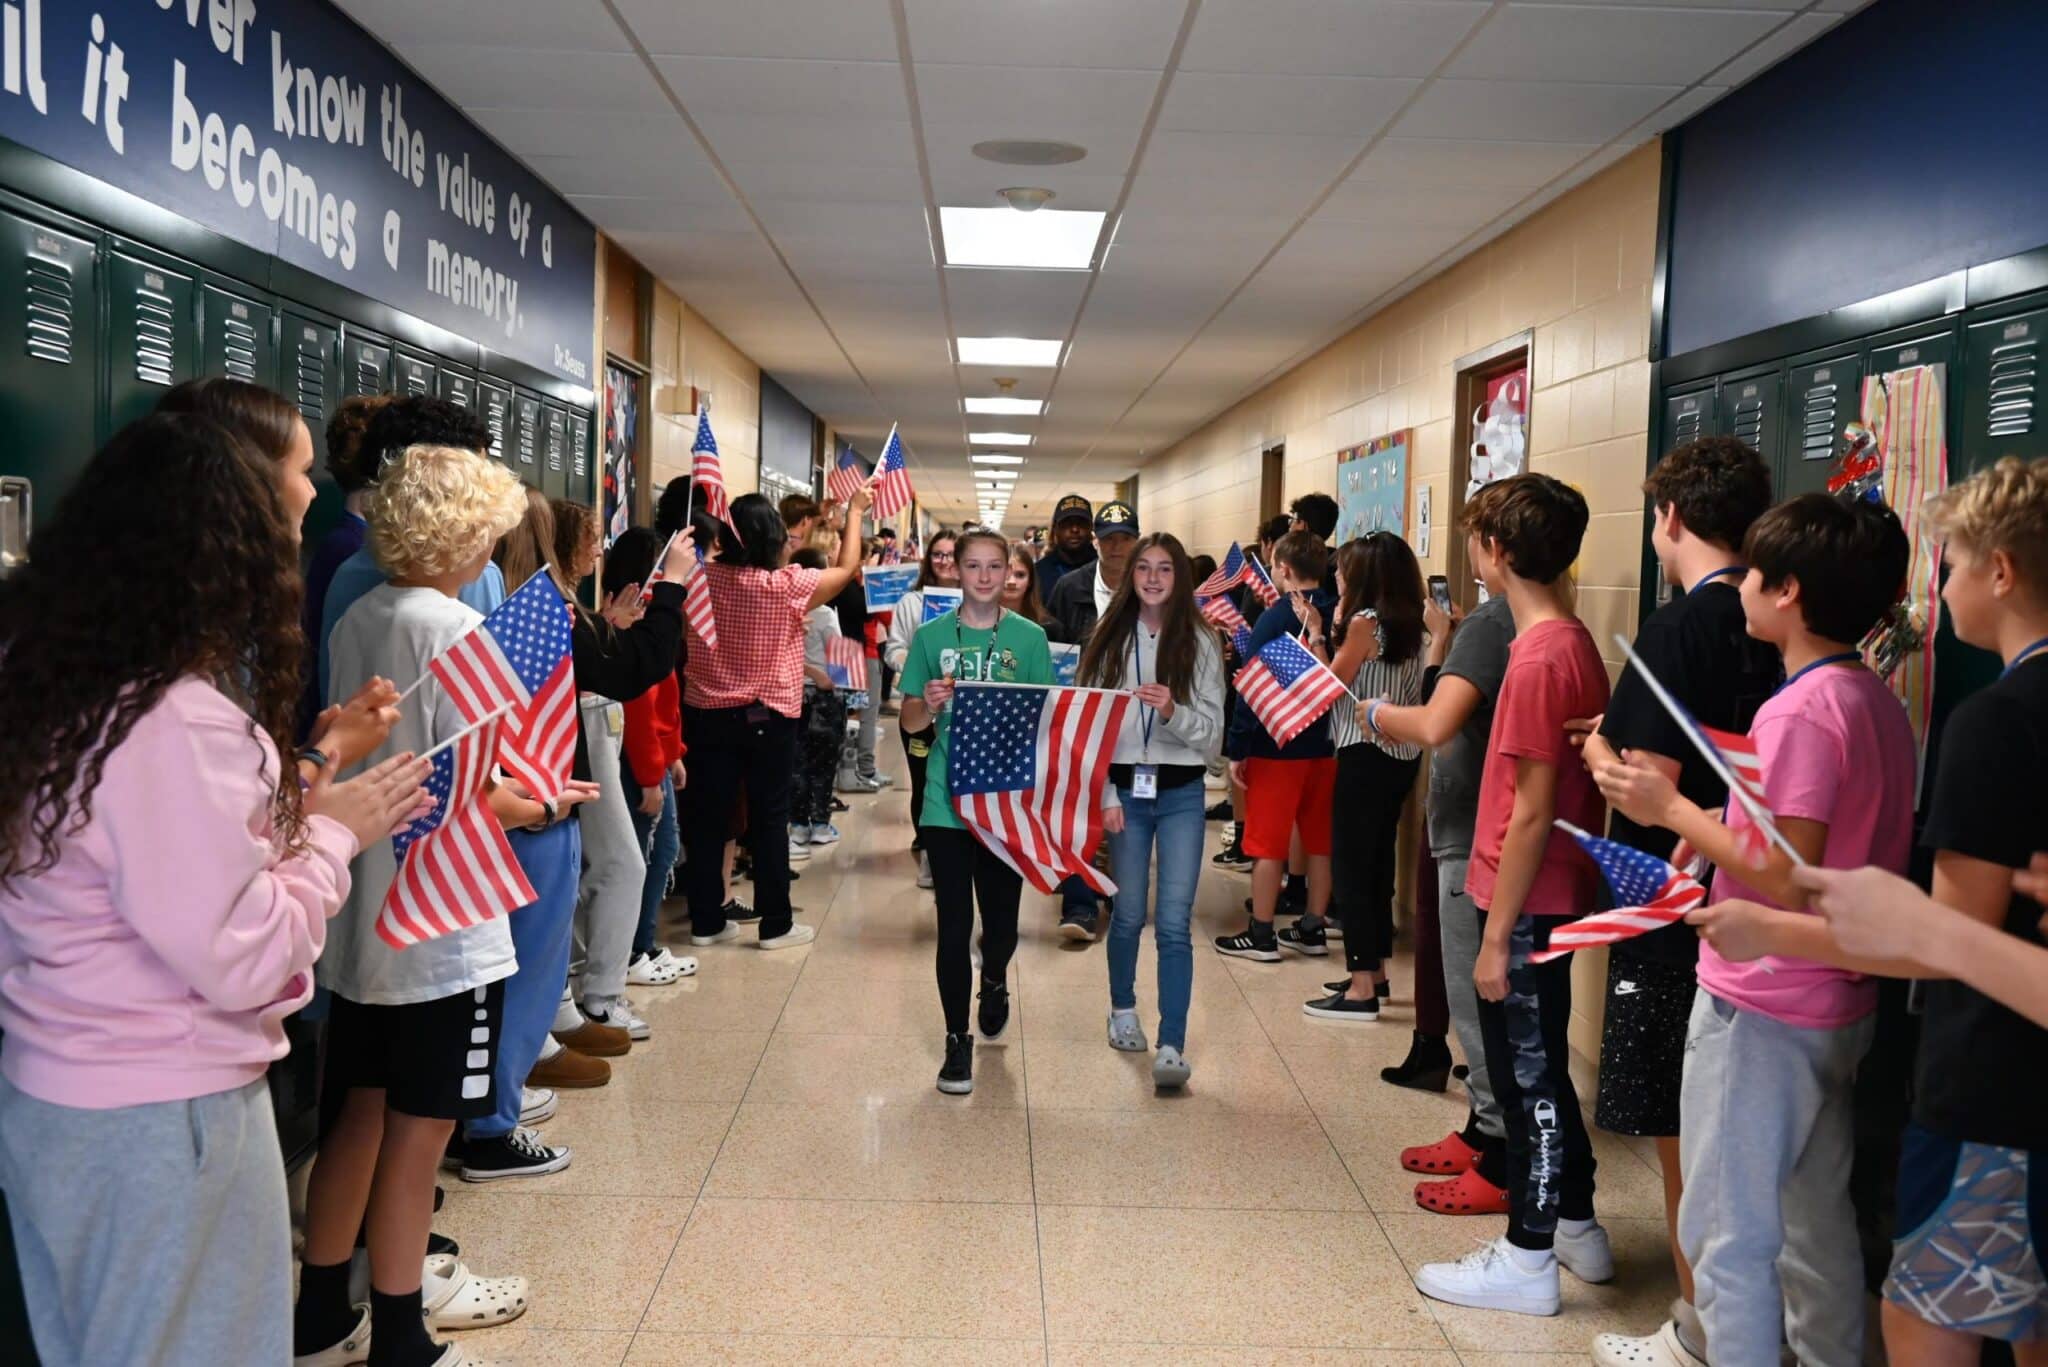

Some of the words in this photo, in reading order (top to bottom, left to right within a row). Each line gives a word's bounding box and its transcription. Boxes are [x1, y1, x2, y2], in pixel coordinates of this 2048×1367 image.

[81, 13, 129, 156] it
[172, 58, 357, 271] becomes
[383, 209, 400, 272] a
[427, 238, 523, 338] memory.
[271, 30, 366, 147] know
[381, 83, 425, 188] the
[436, 152, 495, 235] value
[509, 192, 532, 259] of
[542, 224, 552, 268] a
